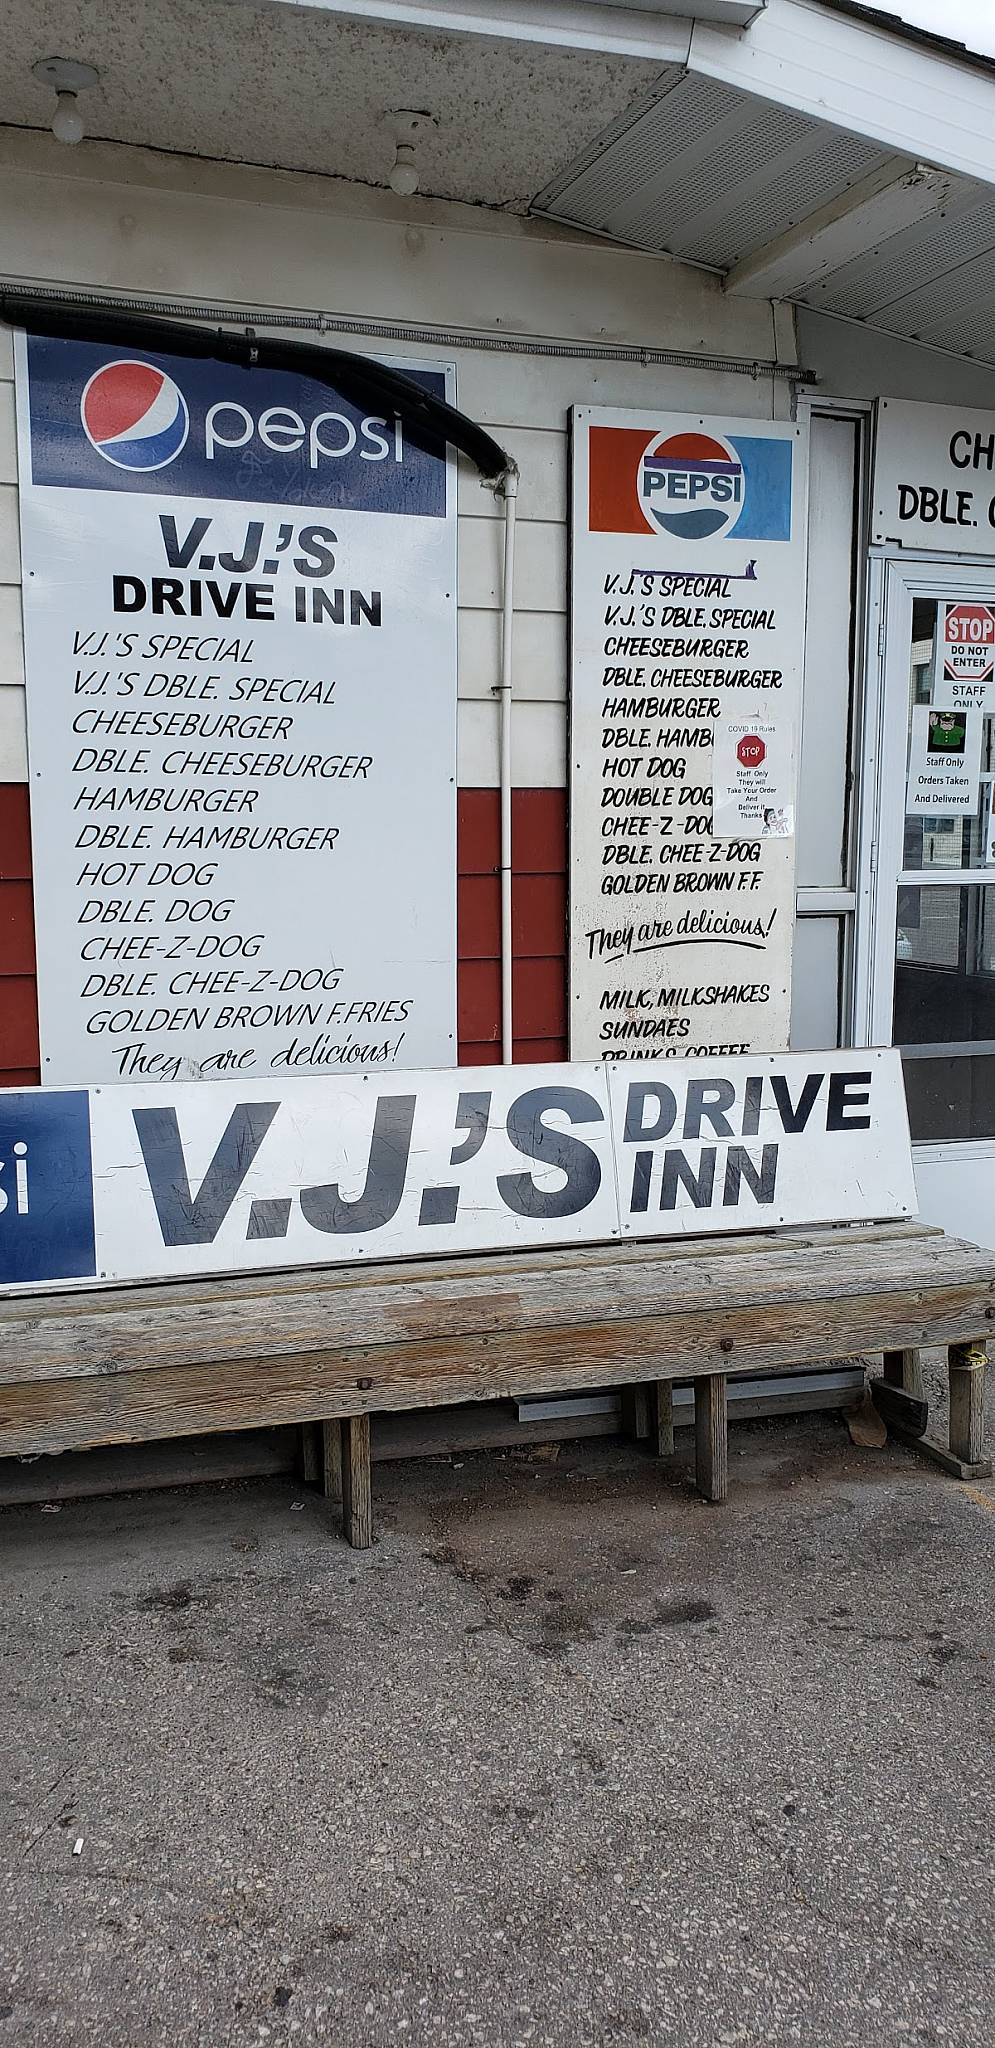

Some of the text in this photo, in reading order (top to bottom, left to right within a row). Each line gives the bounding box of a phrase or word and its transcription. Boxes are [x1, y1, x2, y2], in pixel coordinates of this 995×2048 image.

[205, 401, 402, 469] pepsi
[643, 471, 741, 502] PEPSI
[898, 484, 977, 527] DBLE.
[659, 576, 731, 598] SPECIAL
[112, 575, 382, 627] DRIVE INN
[661, 606, 707, 628] DBLE.
[709, 608, 776, 630] SPECIAL
[948, 617, 993, 641] STOP
[142, 635, 254, 662] SPECIAL
[604, 636, 749, 659] CHEESEBURGER
[951, 646, 989, 656] DO NOT
[953, 658, 986, 667] ENTER
[144, 673, 220, 699] DBLE.
[229, 678, 336, 704] SPECIAL
[602, 667, 783, 689] DBLE. CHEESEBURGER
[952, 686, 986, 696] STAFF
[601, 697, 721, 718] HAMBURGER
[72, 710, 293, 740] CHEESEBURGER
[601, 728, 714, 748] DBLE. HAMB
[72, 749, 373, 779] DBLE. CHEESEBURGER
[741, 747, 760, 757] STOP
[926, 757, 964, 768] Staff Only
[602, 757, 687, 779] HOT DOG
[918, 776, 969, 785] Orders Taken
[73, 787, 259, 812] HAMBURGER
[601, 786, 713, 808] DOUBLE DOG
[915, 794, 969, 804] And Delivered
[75, 825, 340, 851] DBLE. HAMBURGER
[602, 842, 762, 865] DBLE. CHEE-Z-DOG
[76, 863, 218, 886] HOT DOG
[601, 873, 670, 895] GOLDEN
[673, 871, 735, 893] BROWN
[78, 899, 235, 923] DBLE. DOG
[585, 907, 777, 959] They are delicious!
[80, 935, 265, 960] CHEE-Z-DOG
[80, 968, 344, 997] DBLE. CHEE-Z-DOG
[599, 984, 770, 1010] MILK, MILKSHAKES
[86, 1007, 210, 1034] GOLDEN
[214, 1003, 323, 1029] BROWN
[599, 1018, 690, 1040] SUNDAES
[112, 1032, 405, 1080] They are delicious!
[623, 1071, 872, 1143] DRIVE
[630, 1143, 779, 1213] INN
